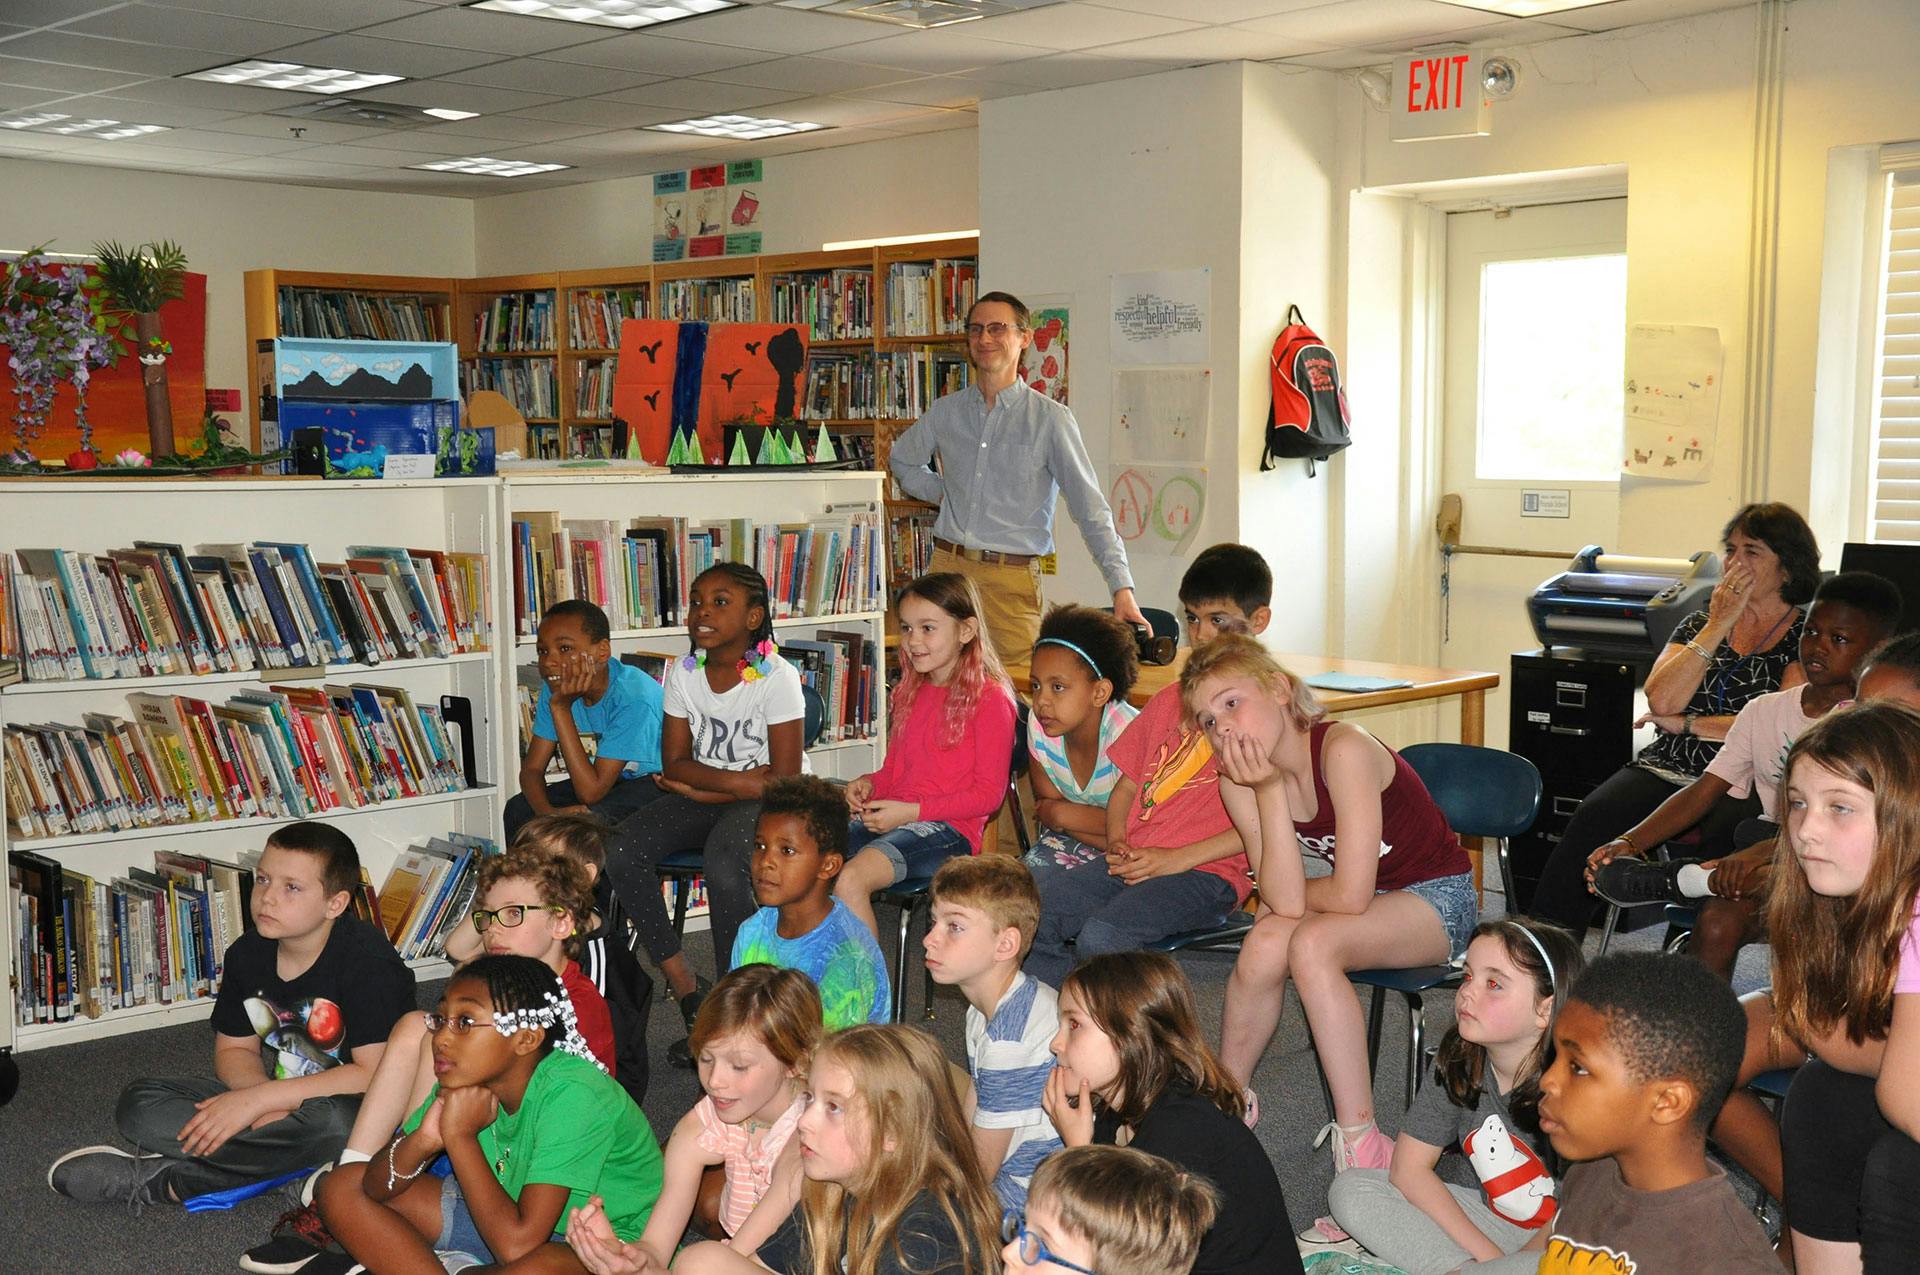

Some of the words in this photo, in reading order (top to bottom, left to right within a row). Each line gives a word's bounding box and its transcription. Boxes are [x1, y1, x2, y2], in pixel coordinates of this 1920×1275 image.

[1408, 55, 1469, 112] EXIT
[1145, 305, 1177, 330] helpful
[67, 556, 85, 587] INDIAN
[76, 586, 99, 626] COUNTRY
